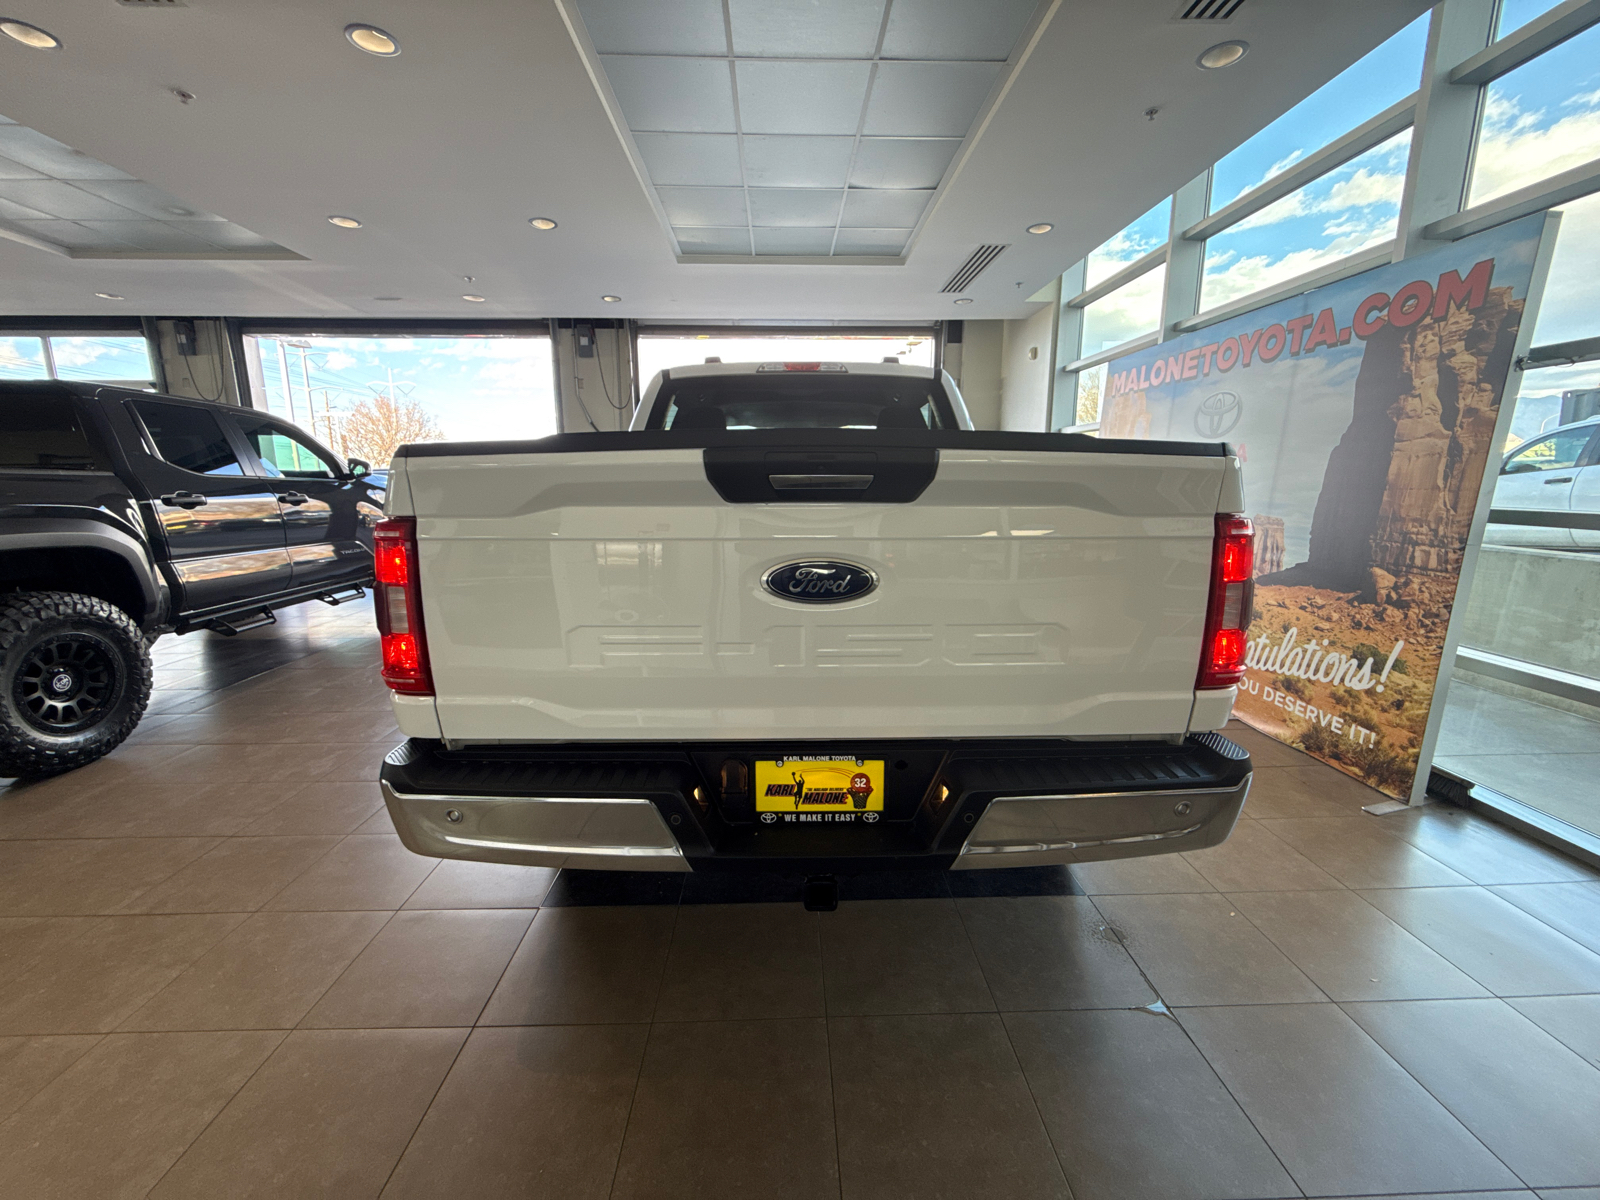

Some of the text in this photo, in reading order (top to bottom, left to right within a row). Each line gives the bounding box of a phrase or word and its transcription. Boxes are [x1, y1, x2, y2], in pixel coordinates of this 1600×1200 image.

[1111, 257, 1496, 398] MALONETOYOTA.COM
[788, 567, 852, 594] Ford
[1245, 627, 1405, 693] atulations!
[1237, 676, 1377, 749] OU DESERVE IT!
[764, 784, 796, 797] KARL
[854, 778, 867, 788] 32
[801, 791, 849, 805] MALONE
[784, 813, 856, 822] WE MAKE IT EASY
